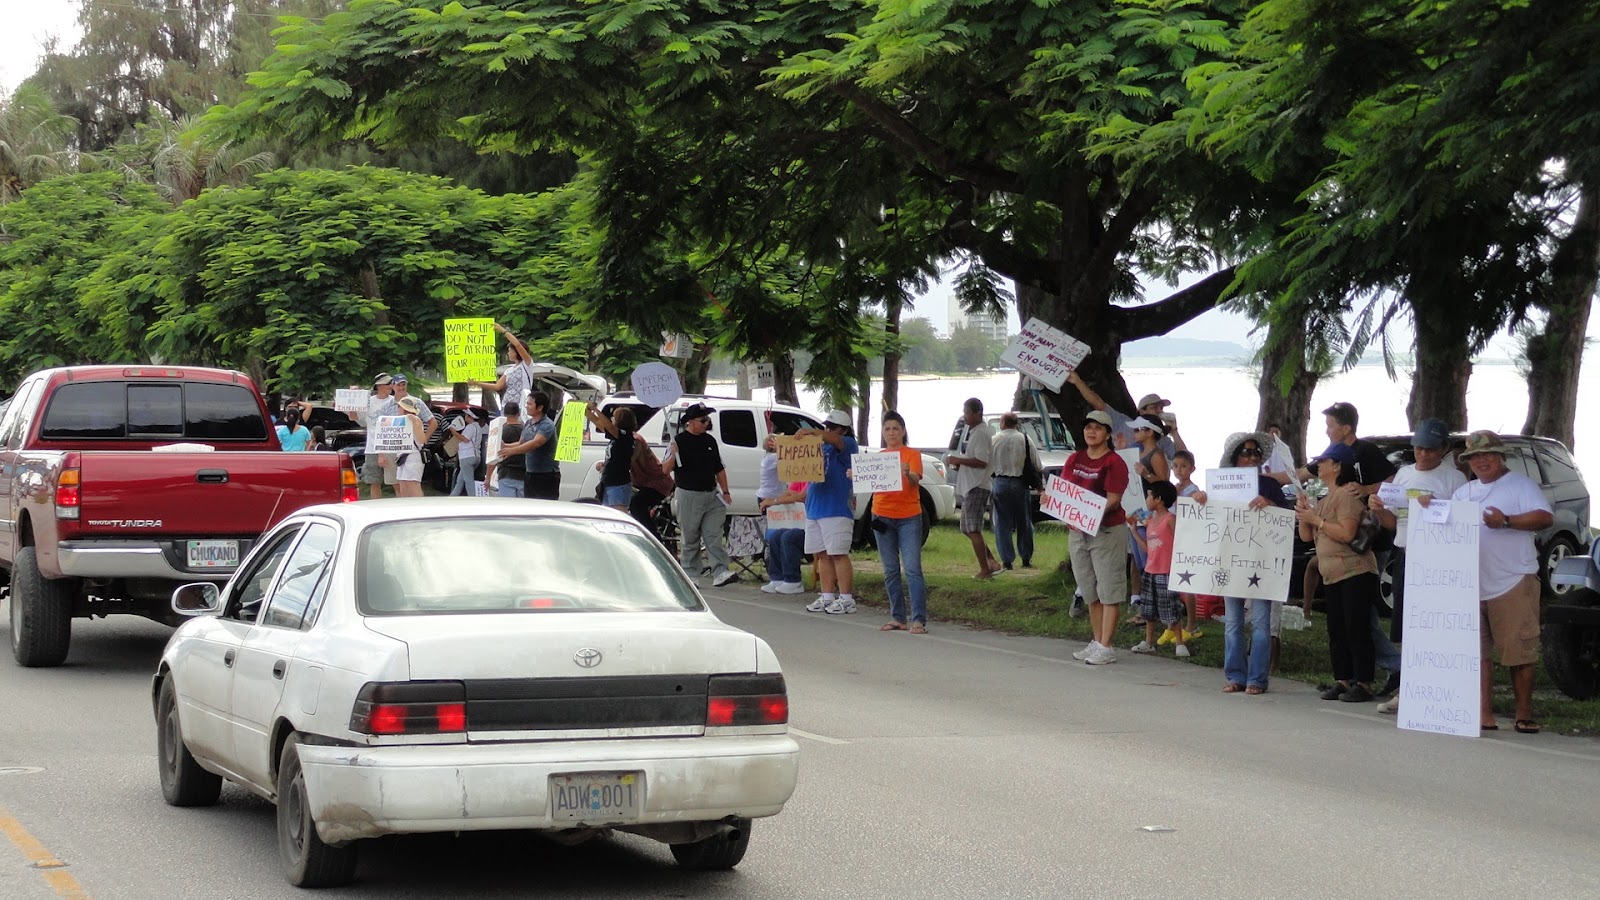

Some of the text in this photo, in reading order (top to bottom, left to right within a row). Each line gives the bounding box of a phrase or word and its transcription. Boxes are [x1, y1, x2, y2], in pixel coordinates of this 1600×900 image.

[446, 323, 475, 332] WAKE
[446, 334, 487, 344] DO NOT
[1022, 340, 1040, 352] ARE
[1036, 336, 1057, 351] MANY
[447, 344, 497, 355] BE AFRAID
[1017, 350, 1064, 378] ENOUGH!
[637, 373, 673, 386] IMPEACH
[642, 383, 673, 395] FITIAL
[778, 444, 823, 461] IMPEACH
[856, 463, 884, 474] DOCTORS
[1046, 495, 1096, 531] IMPEACH
[1178, 503, 1295, 532] TAKE THE POWER
[110, 520, 163, 528] TUNDRA
[1203, 523, 1263, 548] BACK
[190, 546, 237, 561] CHUKANO
[1176, 552, 1222, 567] IMPEACH
[1231, 555, 1271, 570] FITIAL
[1408, 605, 1479, 632] EGOTISTICAL
[1406, 644, 1480, 672] UNPRODUCTIVE
[1424, 704, 1472, 724] MINDED
[557, 783, 633, 811] ADW 001
